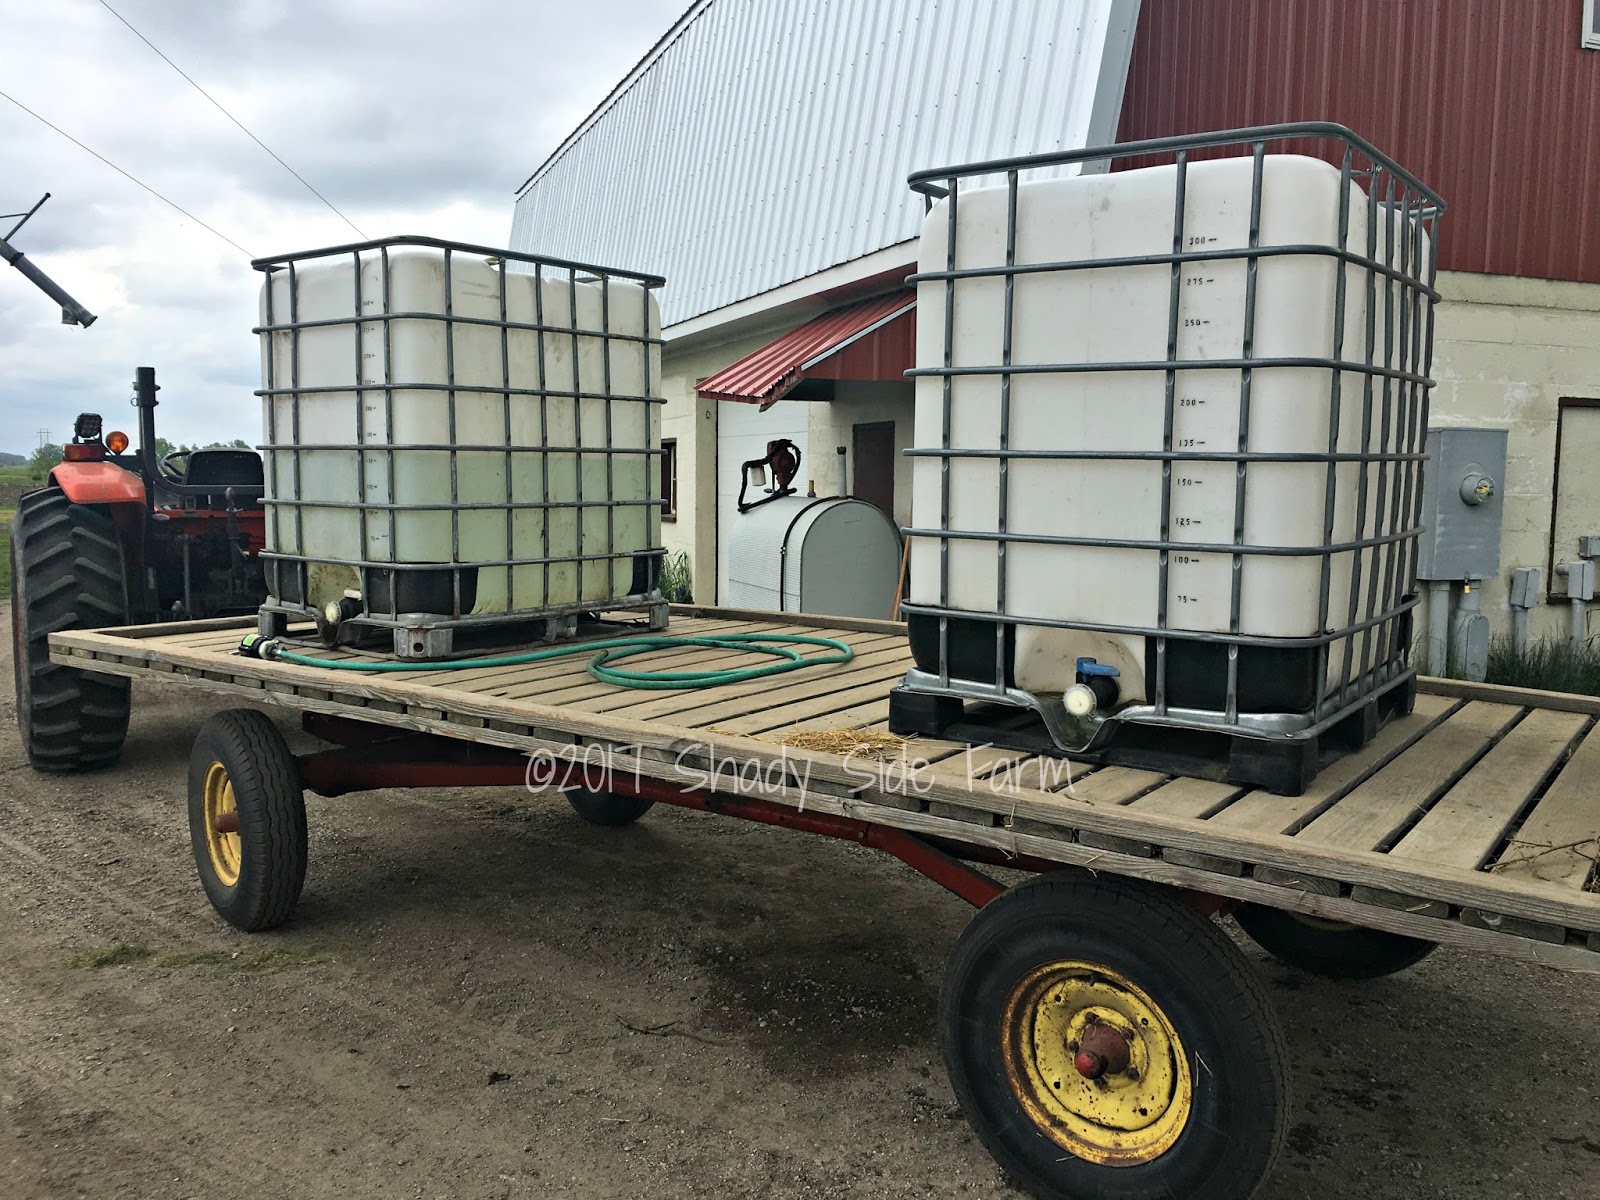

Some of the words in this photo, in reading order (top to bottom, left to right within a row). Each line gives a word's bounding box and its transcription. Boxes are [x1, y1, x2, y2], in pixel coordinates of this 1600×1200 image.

[1189, 236, 1206, 247] 300
[1186, 277, 1203, 286] 275
[1180, 398, 1197, 407] 200
[1177, 478, 1192, 487] 150
[1175, 517, 1190, 528] 125
[1174, 555, 1189, 564] 100
